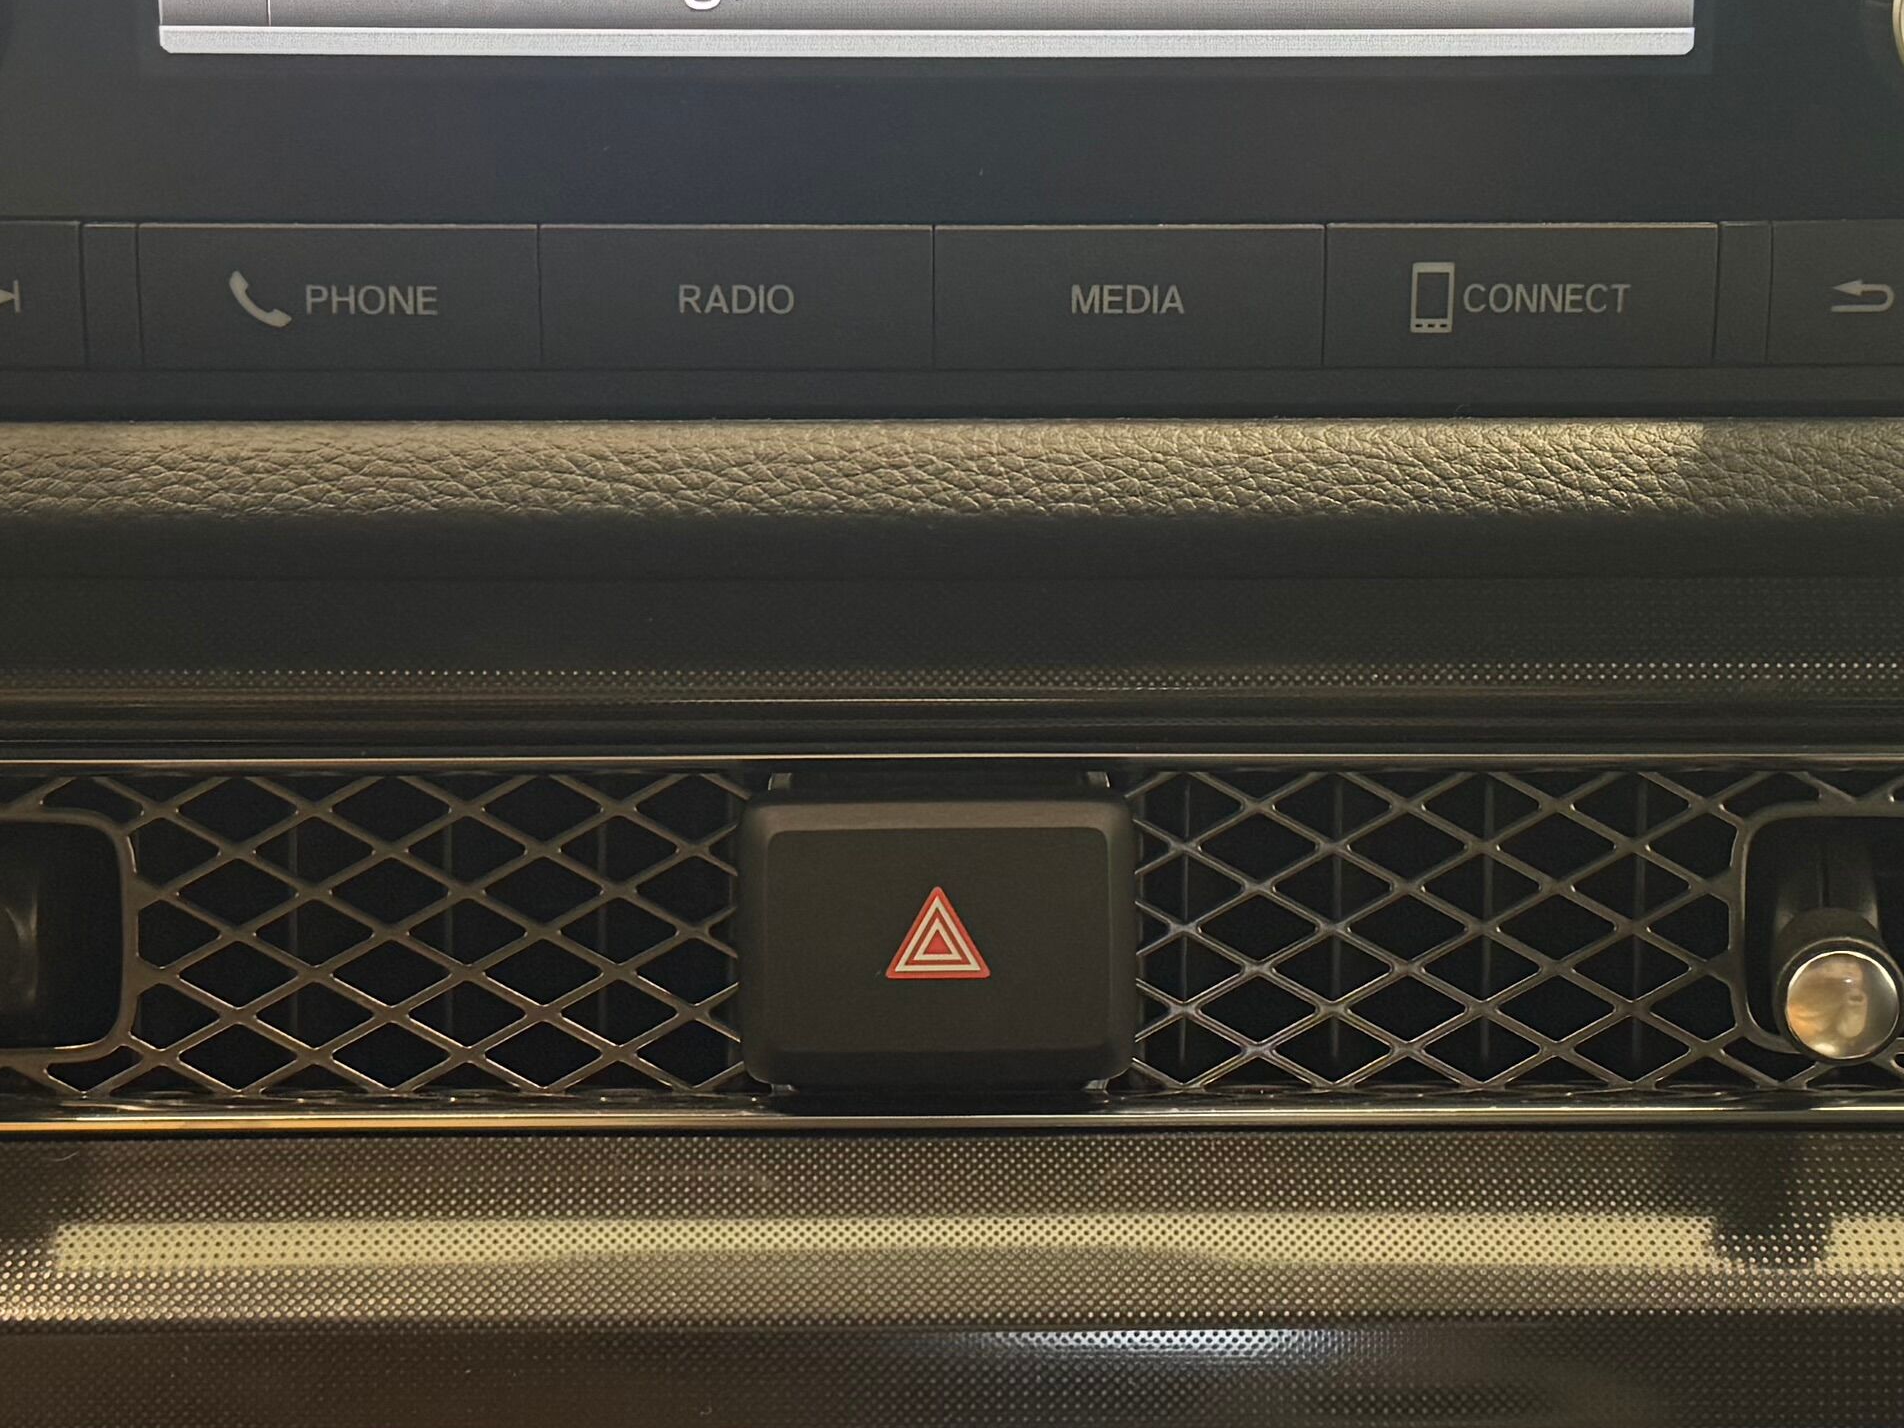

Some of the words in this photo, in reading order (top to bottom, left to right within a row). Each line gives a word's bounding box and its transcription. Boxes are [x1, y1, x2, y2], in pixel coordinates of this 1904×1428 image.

[305, 284, 439, 316] PHONE
[677, 284, 795, 315] RADIO
[1070, 284, 1185, 315] MEDIA
[1462, 283, 1631, 315] CONNECT
